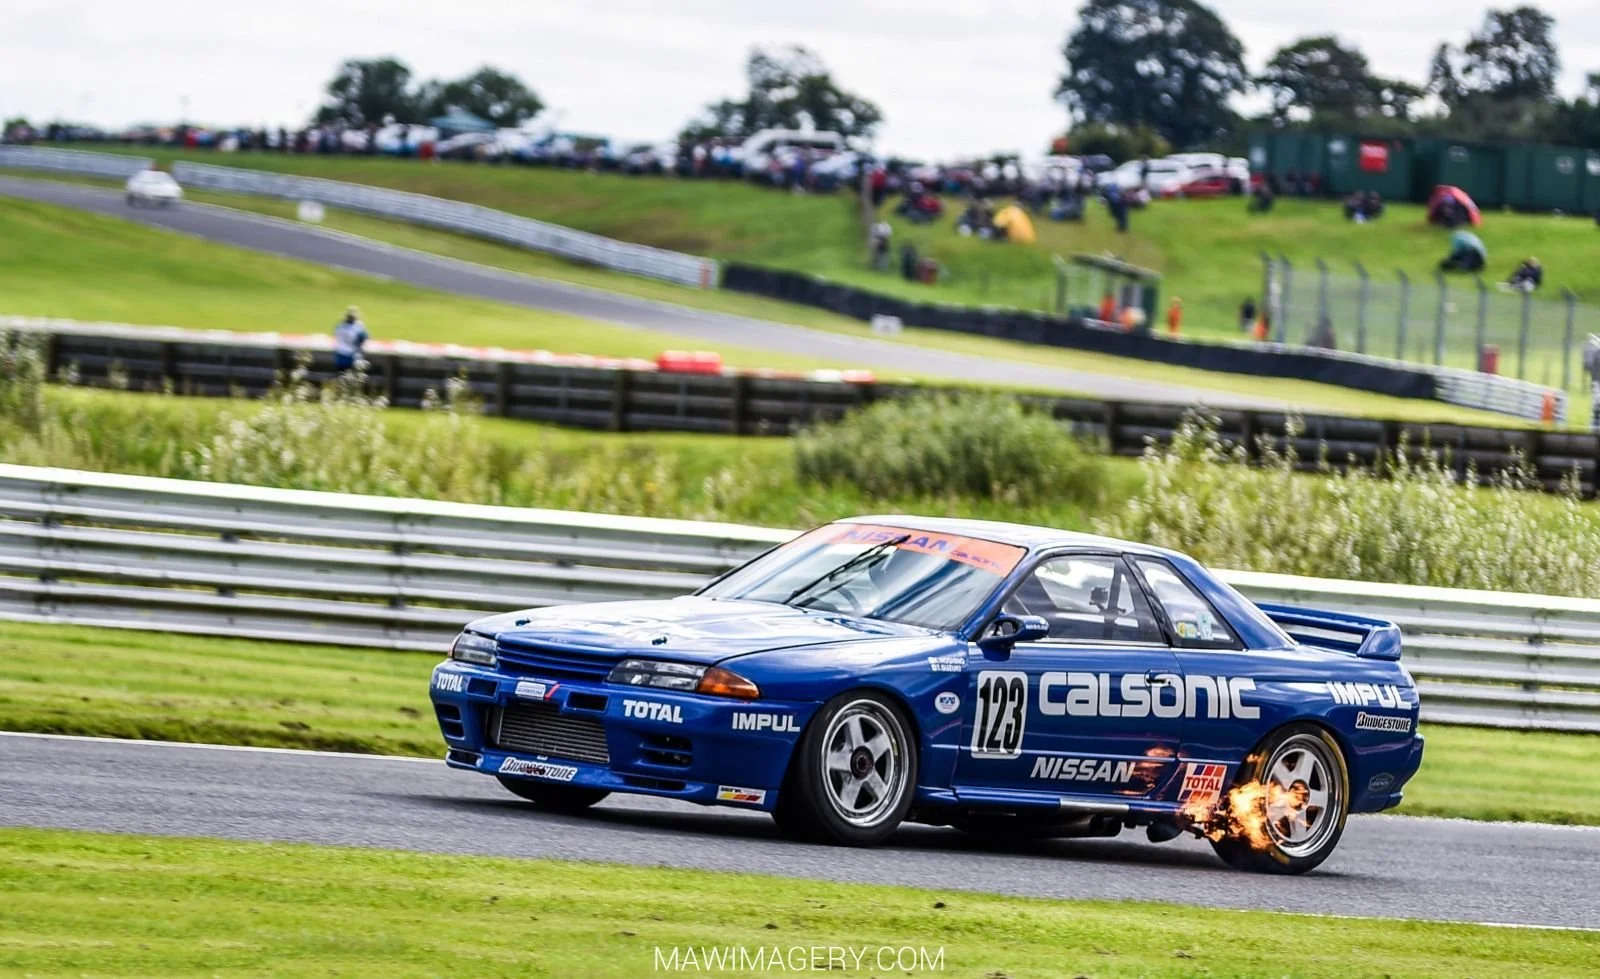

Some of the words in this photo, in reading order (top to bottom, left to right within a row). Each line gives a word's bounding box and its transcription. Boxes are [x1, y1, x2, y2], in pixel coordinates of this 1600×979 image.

[436, 672, 463, 692] TOTAL
[1039, 672, 1261, 719] CALSONIC
[1326, 681, 1412, 710] IMPUL
[623, 700, 683, 724] TOTAL
[732, 712, 800, 732] IMPUL
[977, 675, 1025, 754] 123
[1356, 712, 1411, 732] BRIDGESTONE
[1030, 757, 1135, 783] NISSAN
[1185, 776, 1221, 791] TOTAL
